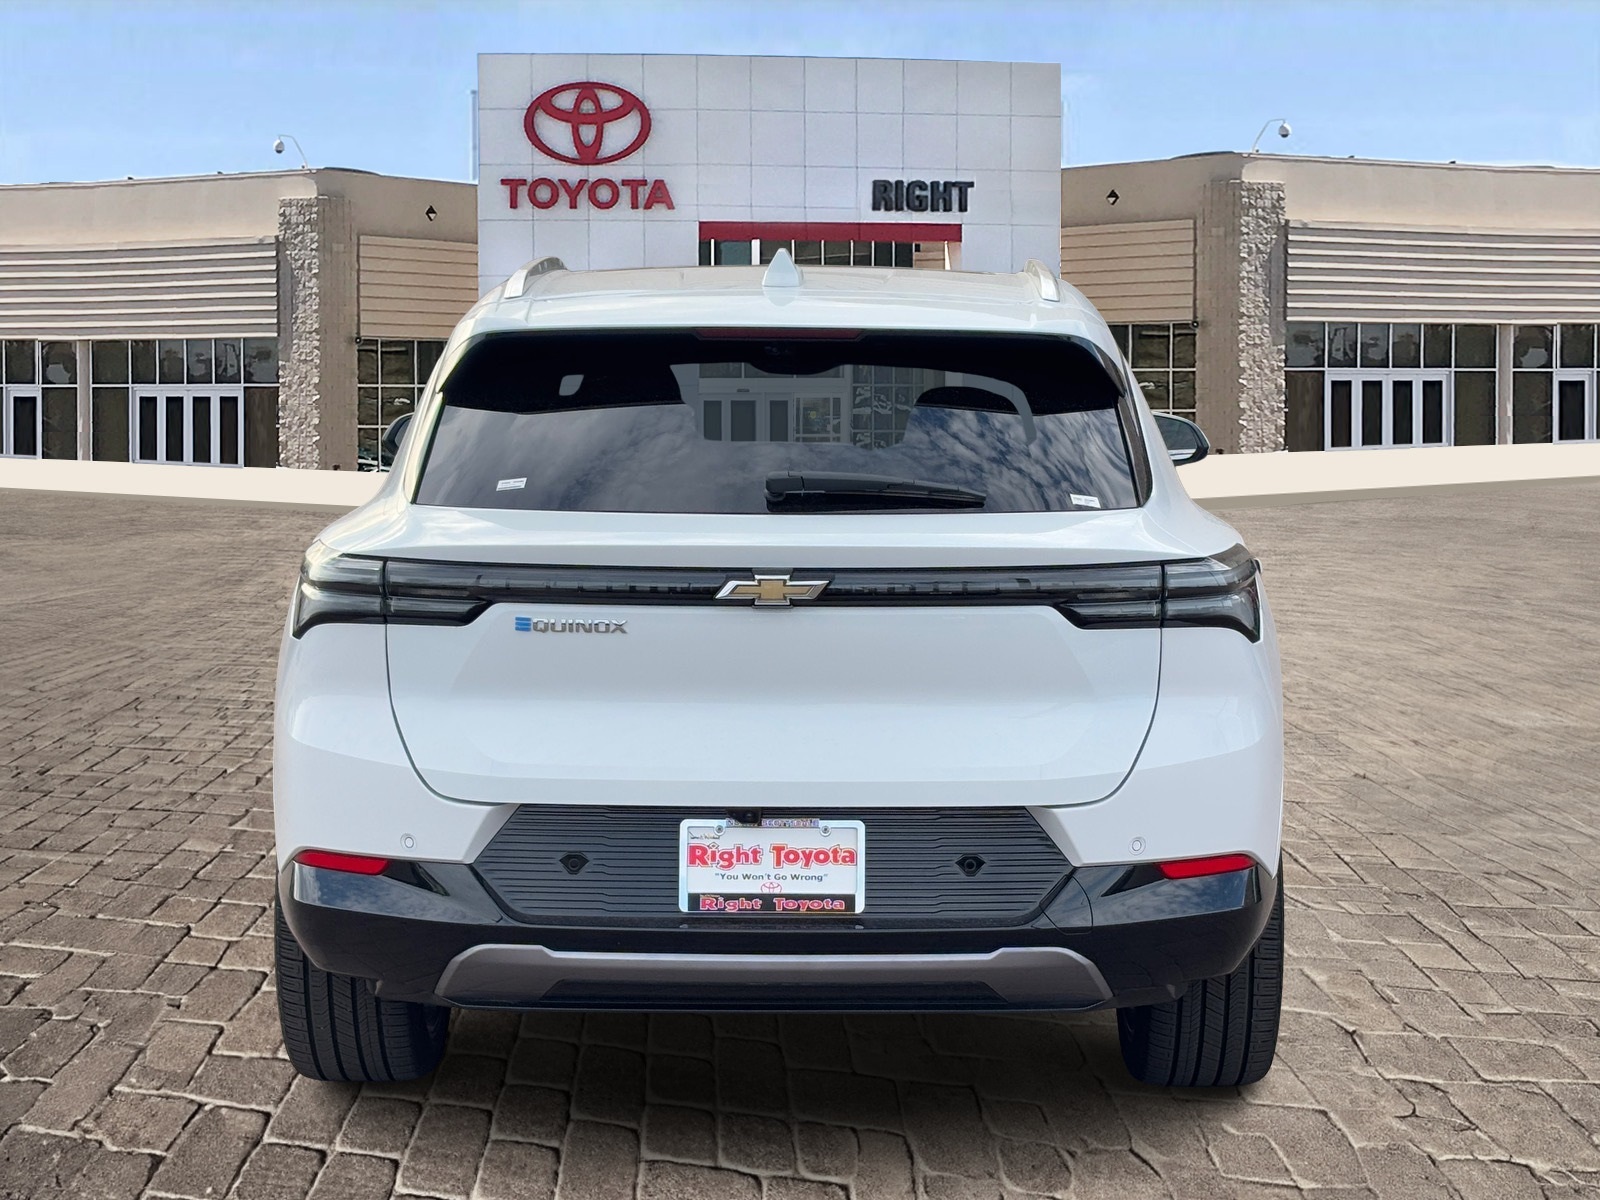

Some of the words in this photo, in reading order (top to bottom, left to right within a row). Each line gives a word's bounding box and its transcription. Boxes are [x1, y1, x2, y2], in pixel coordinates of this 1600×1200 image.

[500, 177, 675, 210] TOYOTA
[872, 179, 975, 212] RIGHT
[515, 616, 627, 633] EQUINOX
[687, 842, 763, 870] Right
[770, 844, 858, 869] Toyota
[742, 873, 772, 881] Won't
[774, 873, 787, 881] Go
[700, 897, 762, 912] Right
[773, 897, 845, 910] Toyota
